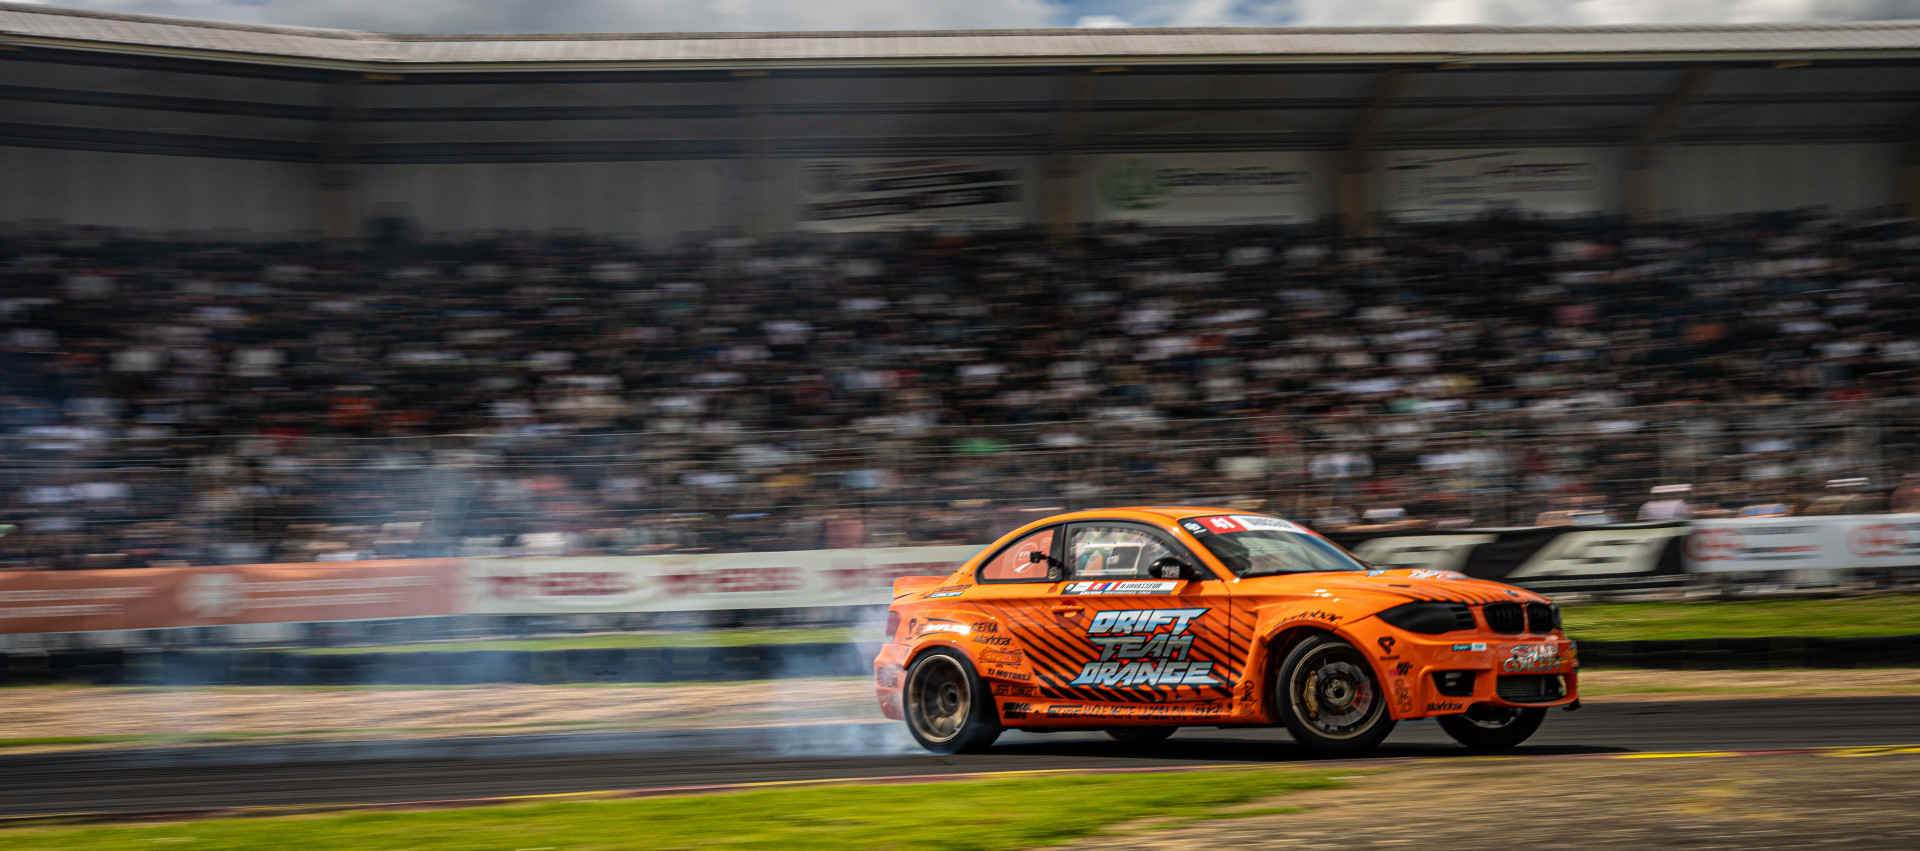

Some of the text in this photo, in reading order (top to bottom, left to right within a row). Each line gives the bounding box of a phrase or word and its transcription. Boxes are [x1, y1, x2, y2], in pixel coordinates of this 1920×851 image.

[1086, 608, 1212, 635] DRIFT
[1086, 633, 1196, 661] TEAM
[1065, 658, 1223, 687] ORANGE
